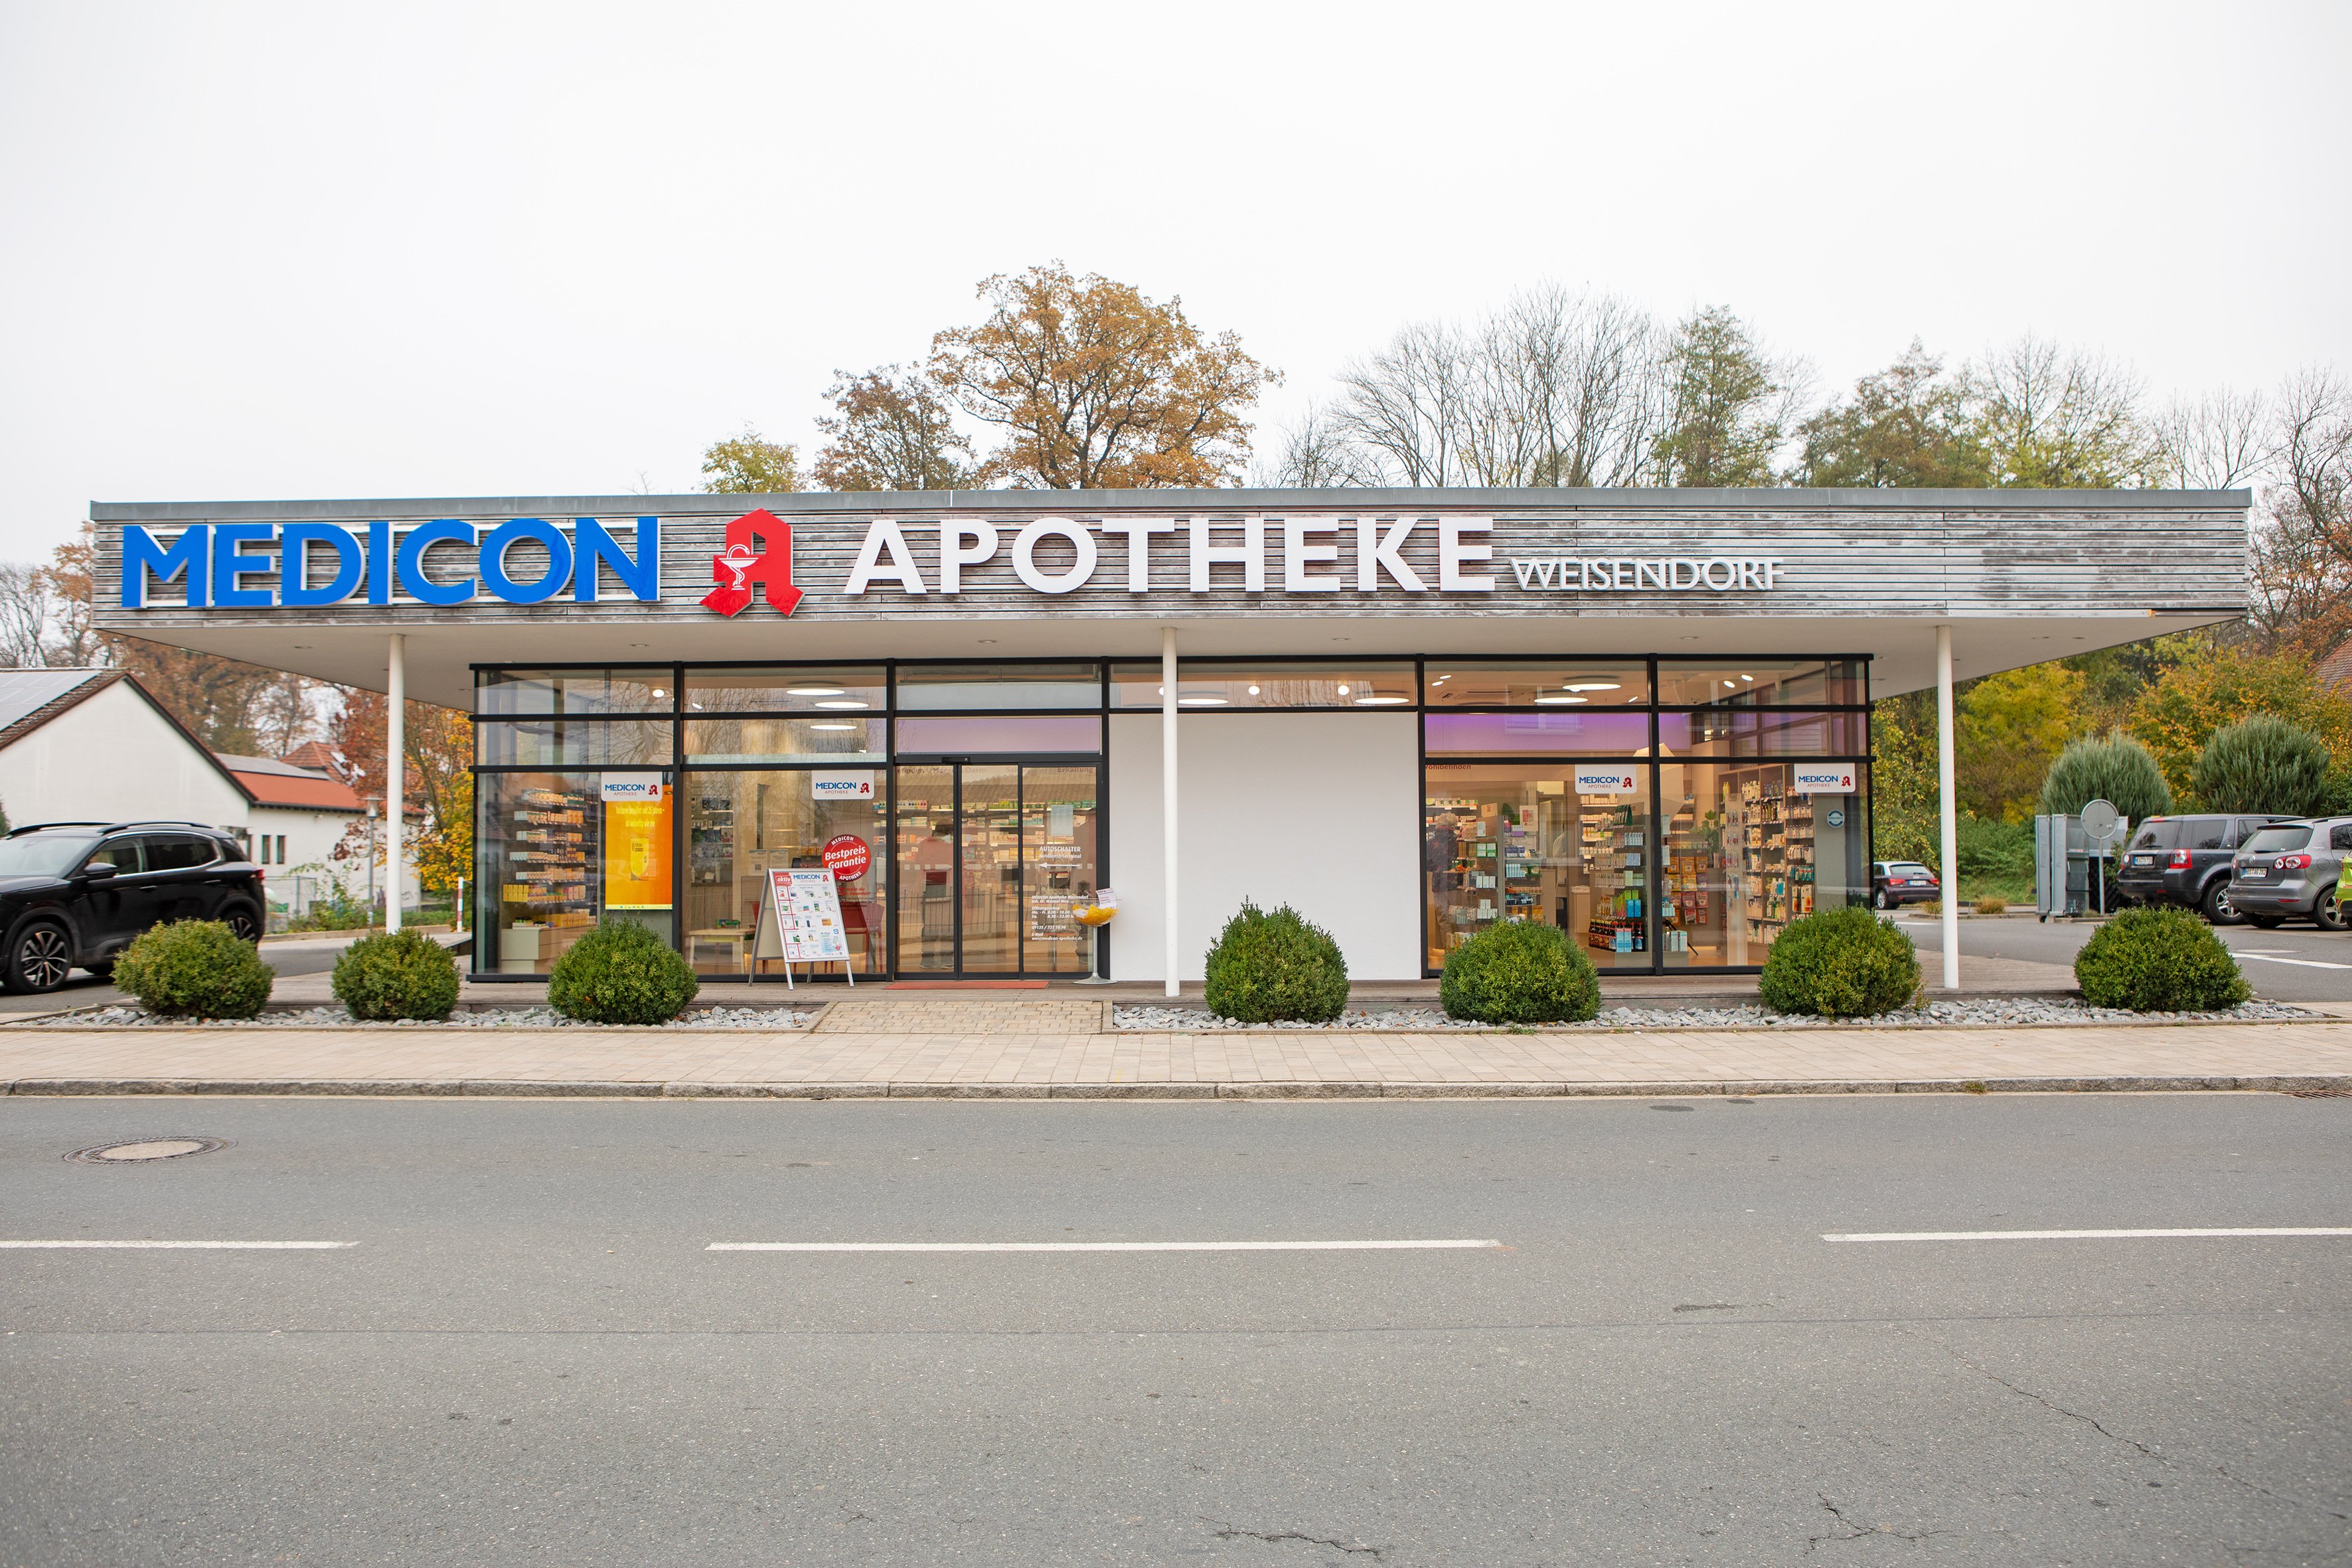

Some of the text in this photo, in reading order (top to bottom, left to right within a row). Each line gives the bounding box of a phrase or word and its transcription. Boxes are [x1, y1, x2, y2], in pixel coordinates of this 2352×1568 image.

[121, 517, 661, 609] MEDICON
[844, 517, 1496, 594] APOTHEKE
[1510, 557, 1784, 591] WEISENDORF
[831, 836, 854, 846] MEDICON
[825, 845, 866, 860] Bestpreis
[828, 856, 866, 869] Garantie
[839, 871, 862, 880] APOTHEKE
